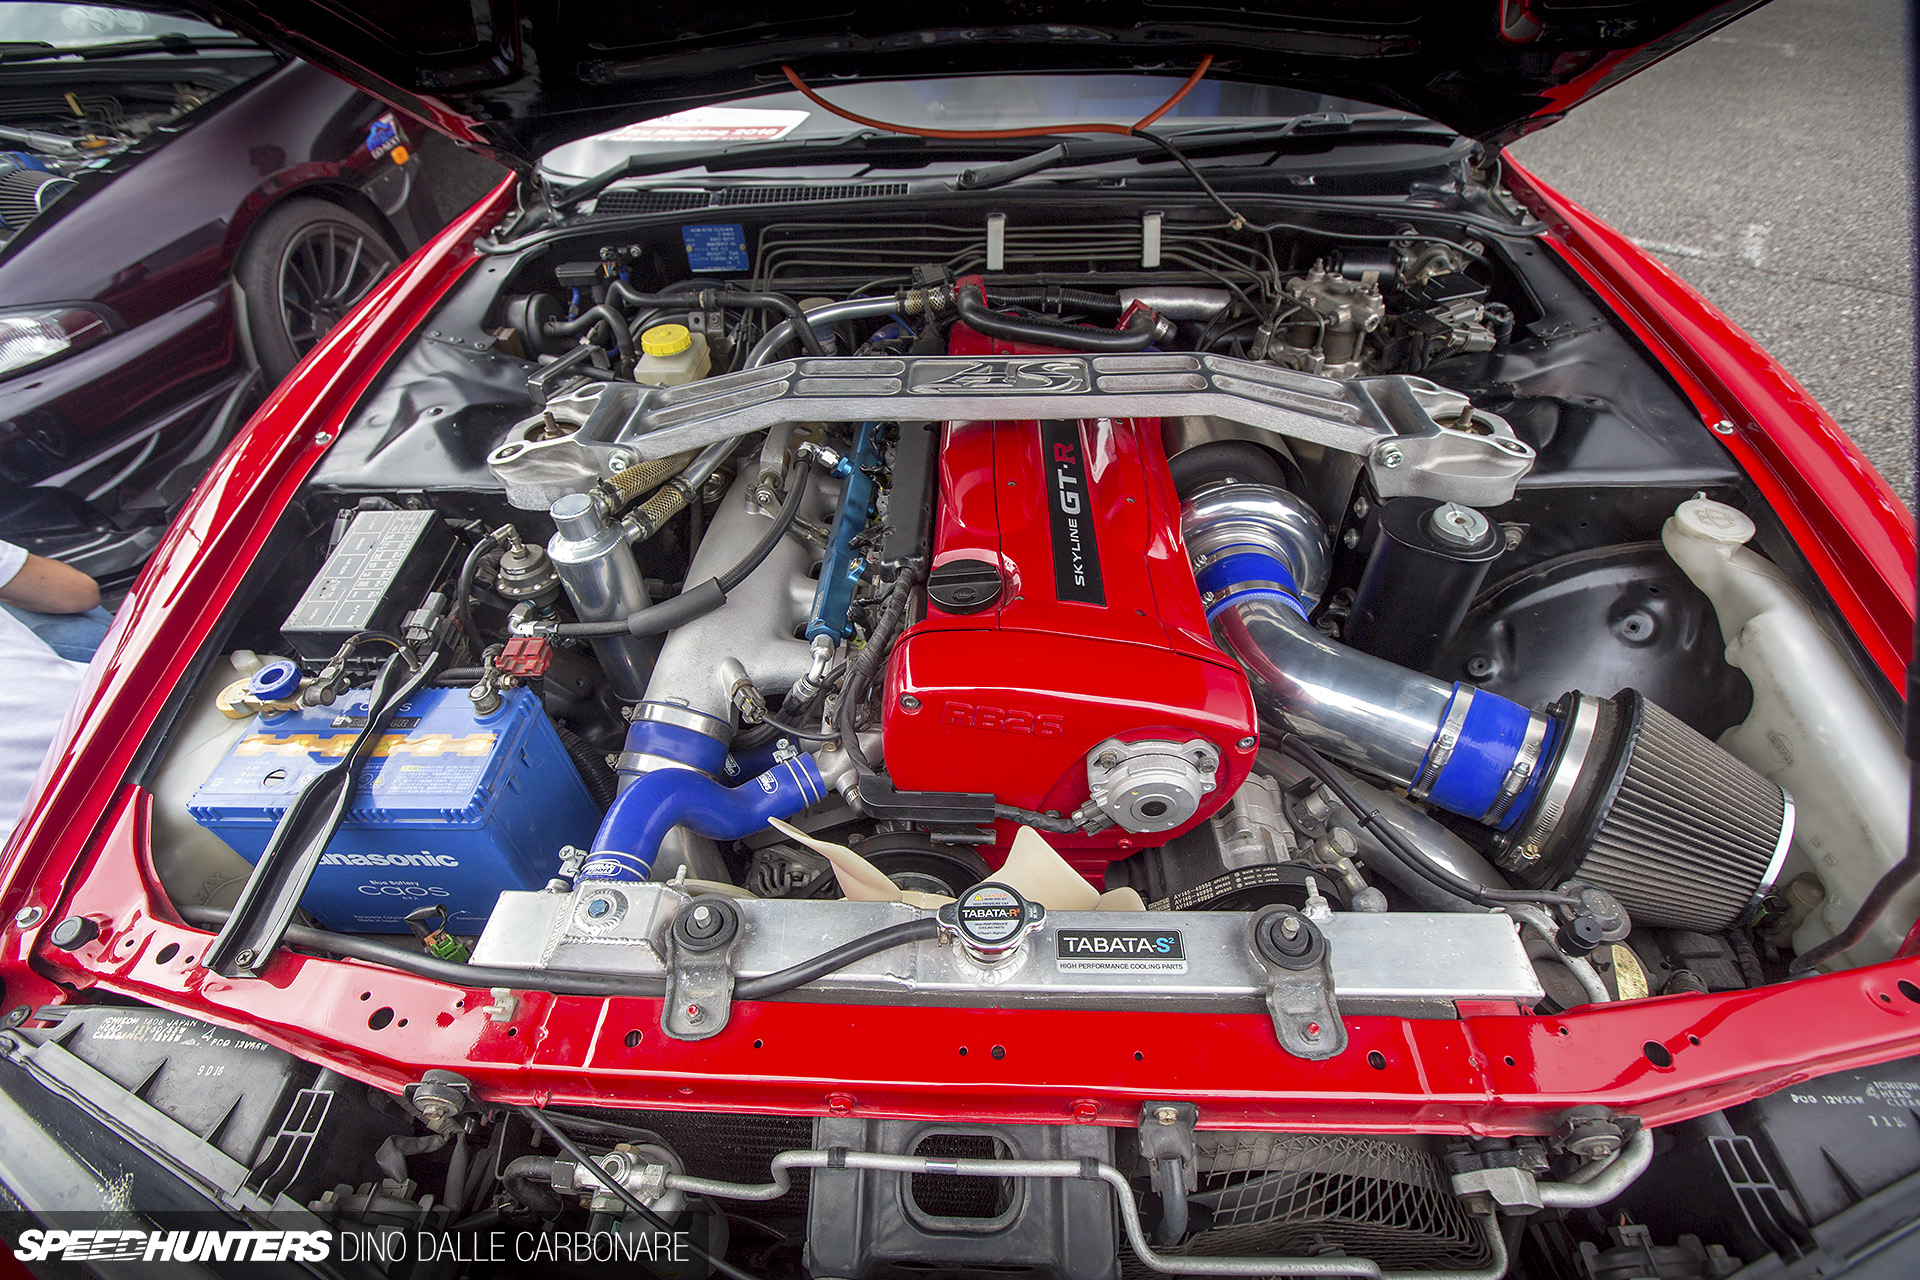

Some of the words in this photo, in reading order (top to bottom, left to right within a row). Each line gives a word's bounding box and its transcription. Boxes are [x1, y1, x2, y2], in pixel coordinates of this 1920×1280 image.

[731, 128, 780, 136] 2016
[1067, 518, 1086, 587] SKYLINE
[942, 700, 1064, 738] RB26
[319, 850, 459, 867] anasonic
[358, 885, 450, 897] caos
[1060, 962, 1077, 970] HIGH
[97, 1023, 123, 1032] HEAD
[166, 1019, 198, 1028] JAPAN
[1880, 1090, 1912, 1099] HEAD
